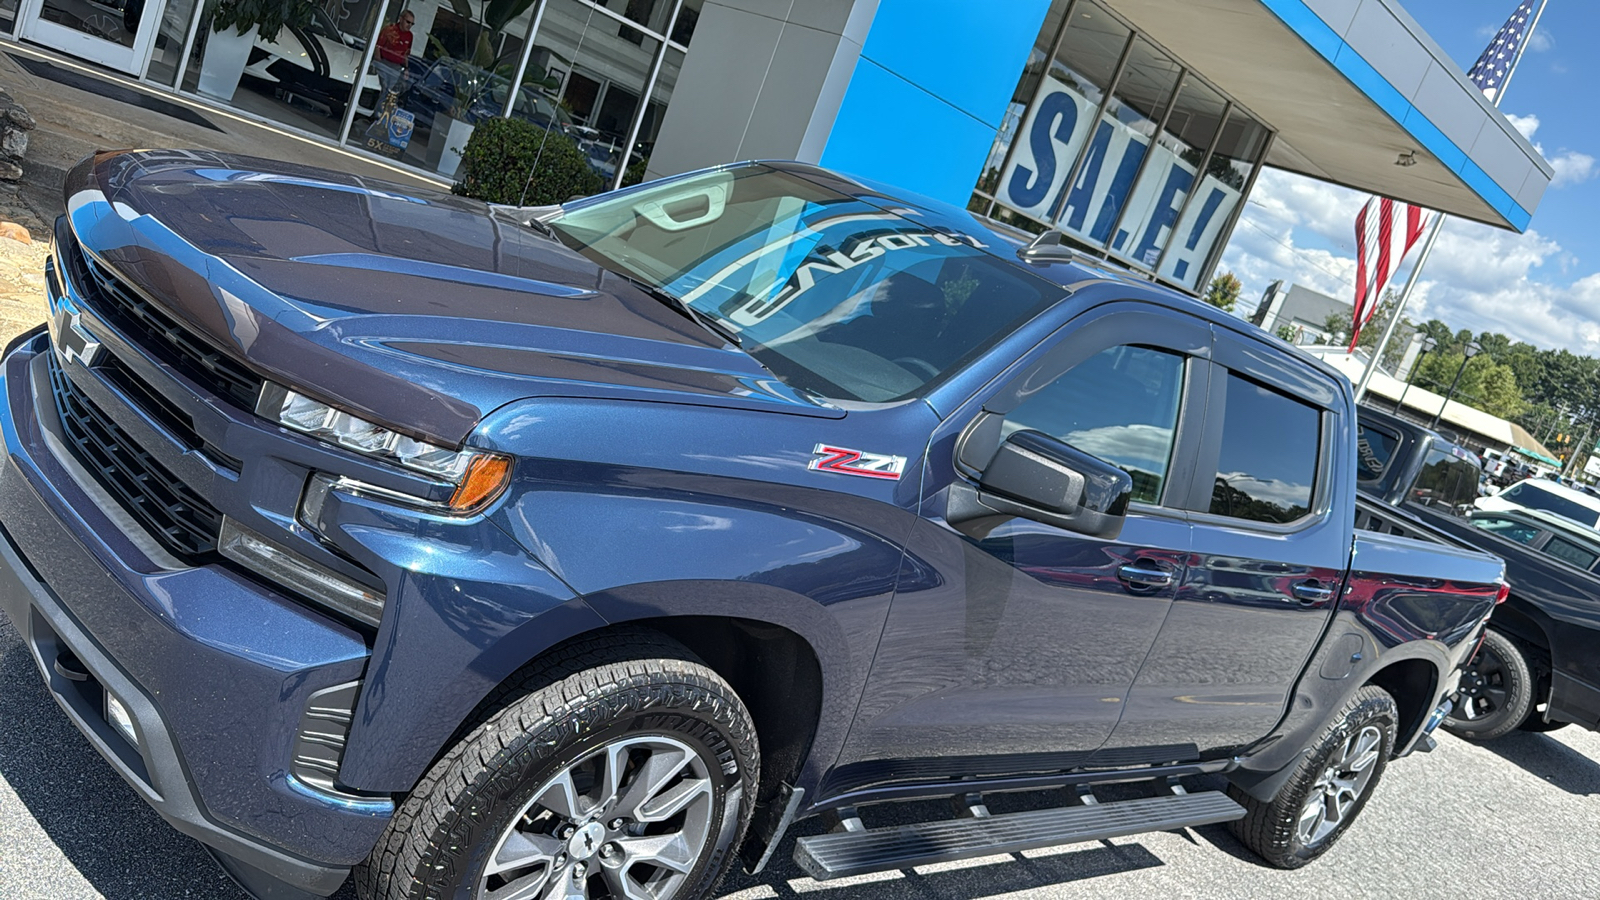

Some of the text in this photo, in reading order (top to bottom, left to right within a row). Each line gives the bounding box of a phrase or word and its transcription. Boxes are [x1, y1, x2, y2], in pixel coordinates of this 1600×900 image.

[1008, 91, 1227, 280] SALE!
[807, 442, 907, 480] Z71
[641, 714, 738, 776] WRANGLER
